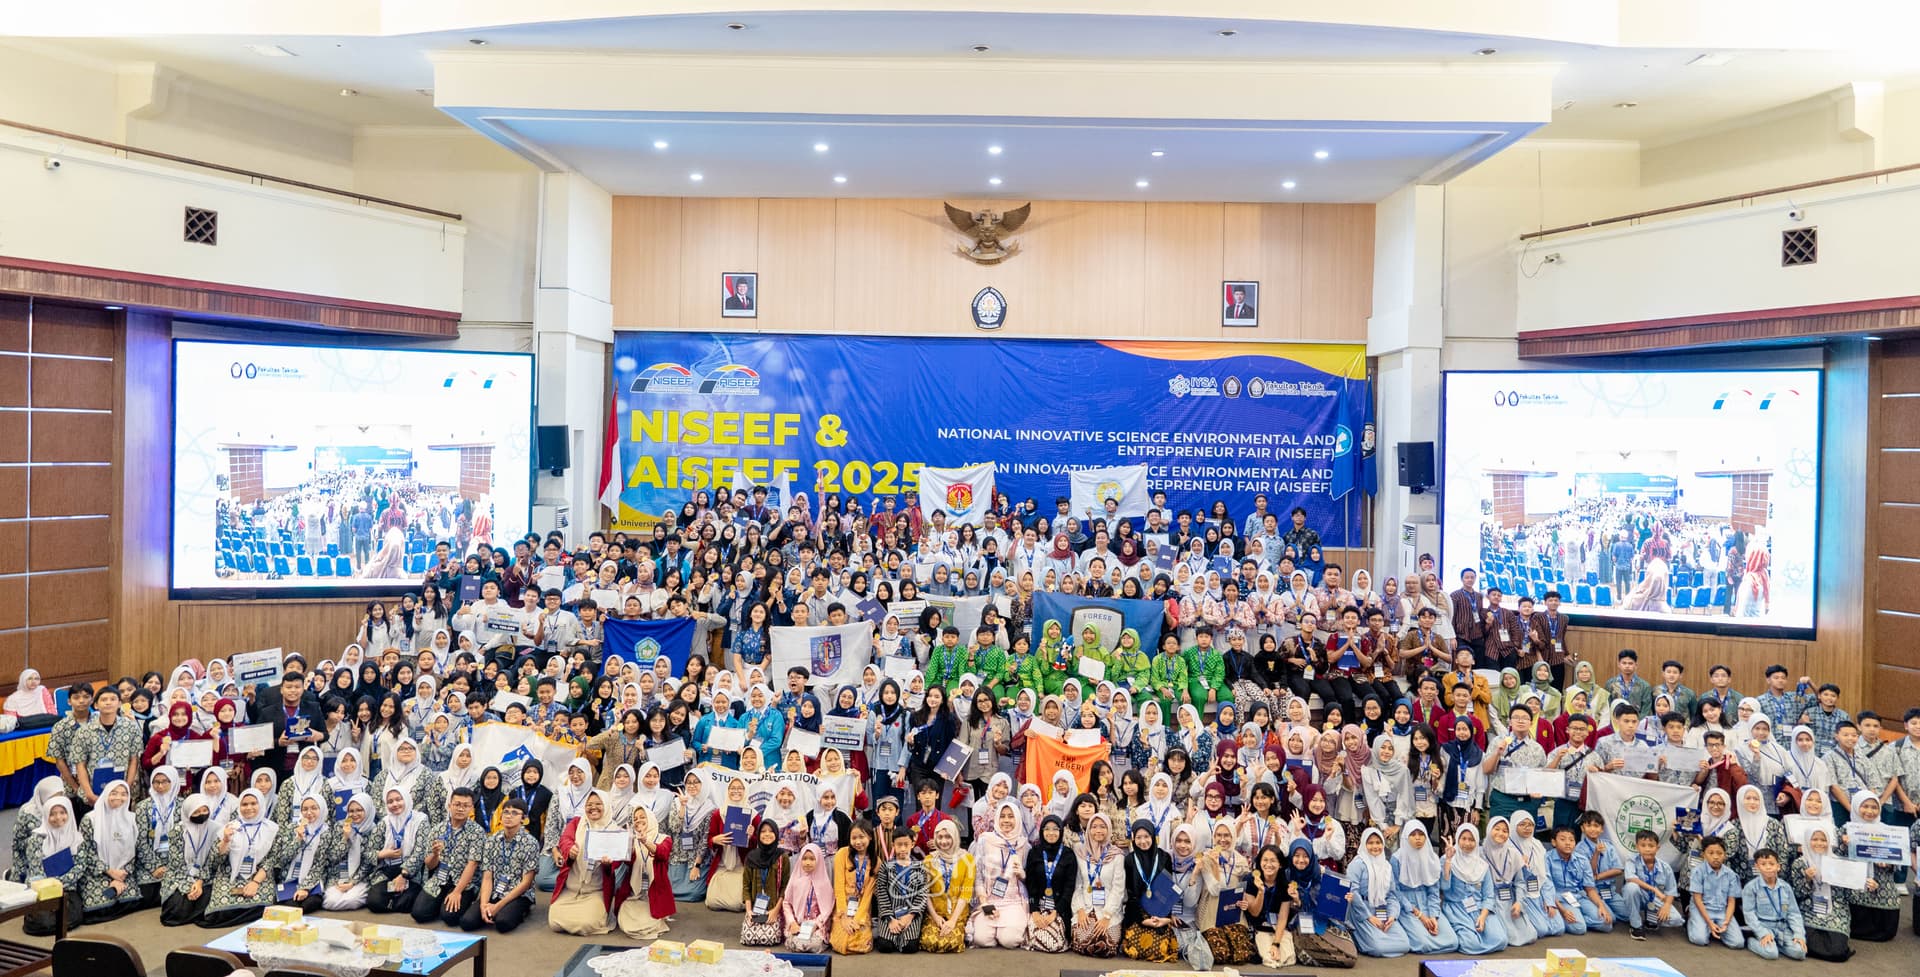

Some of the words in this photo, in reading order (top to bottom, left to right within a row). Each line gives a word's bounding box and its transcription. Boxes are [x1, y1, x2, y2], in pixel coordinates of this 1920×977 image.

[652, 376, 693, 385] NISEEF
[1190, 376, 1218, 388] IYSA
[1265, 380, 1297, 390] Fakultas
[630, 410, 800, 446] NISEEF
[815, 414, 848, 447] &
[937, 428, 1012, 440] NATIONAL
[1015, 430, 1104, 442] INNOVATIVE
[1107, 431, 1169, 443] SCIENCE
[1174, 432, 1300, 445] ENVIRONMENTAL
[1303, 434, 1336, 446] AND
[1117, 445, 1234, 458] ENTREPRENEUR
[1238, 447, 1271, 459] FAIR
[1275, 447, 1335, 462] (NISEEF)
[628, 455, 800, 491] AISEEF
[813, 460, 926, 494] 2025
[1172, 466, 1298, 479] ENVIRONMENTAL
[1301, 468, 1333, 480] AND
[1146, 479, 1233, 492] REPRENEUR
[1238, 481, 1270, 493] FAIR
[620, 519, 656, 528] Universit
[1055, 760, 1085, 772] NEGERI
